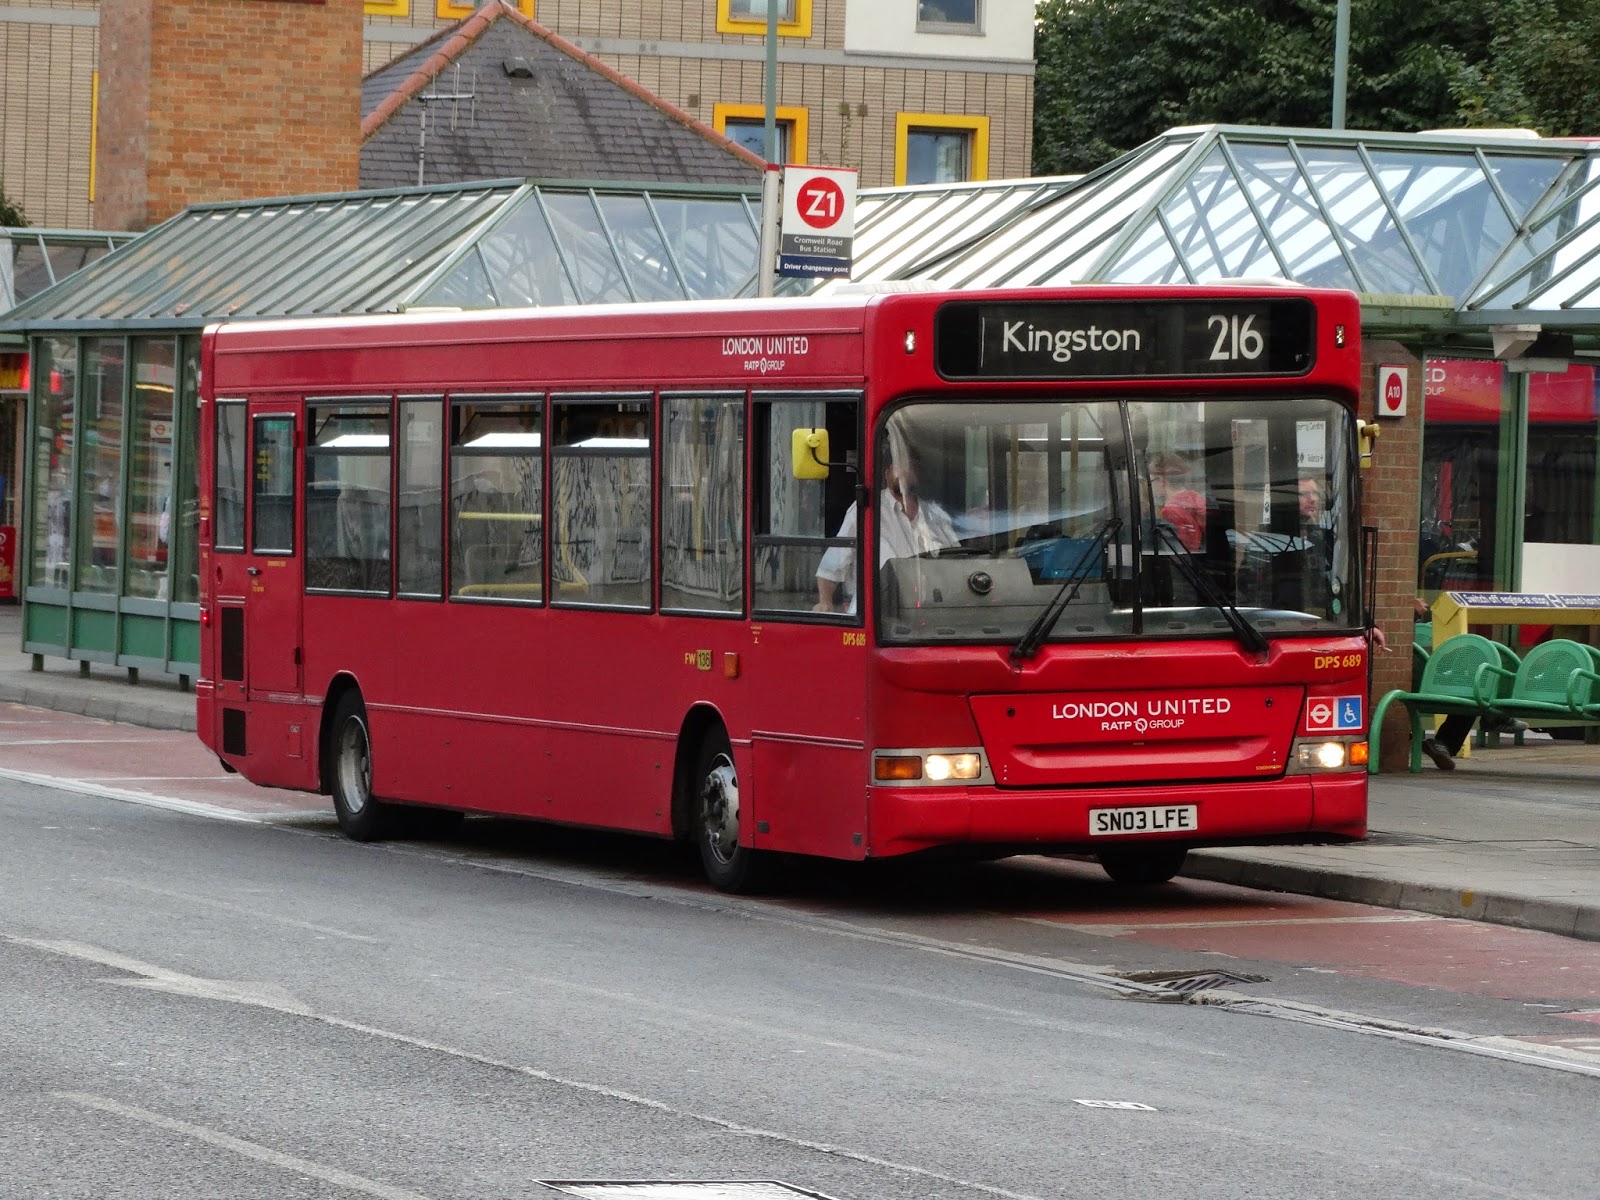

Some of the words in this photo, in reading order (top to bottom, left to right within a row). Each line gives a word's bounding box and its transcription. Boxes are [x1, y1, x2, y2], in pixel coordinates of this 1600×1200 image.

[806, 189, 836, 217] Z1
[794, 236, 825, 245] Cromwell
[827, 238, 843, 246] Road
[813, 246, 837, 254] Station
[802, 264, 833, 272] changeover
[722, 337, 762, 355] LONDON
[767, 336, 808, 355] UNITED
[1003, 321, 1141, 363] Kingston
[1208, 314, 1264, 361] 216
[744, 361, 760, 371] RATP
[767, 360, 785, 371] GROUP
[1387, 386, 1400, 398] A10
[843, 632, 855, 646] DPS
[856, 633, 866, 646] 689
[685, 653, 696, 664] FW
[699, 653, 710, 667] 136
[1314, 656, 1340, 669] DPS
[1342, 654, 1362, 667] 689
[1053, 701, 1138, 719] LONDON
[1147, 698, 1231, 716] UNITED
[1101, 721, 1132, 731] RATP
[1149, 719, 1185, 729] GROUP
[1097, 811, 1147, 831] SN03
[1152, 808, 1189, 829] LFE
